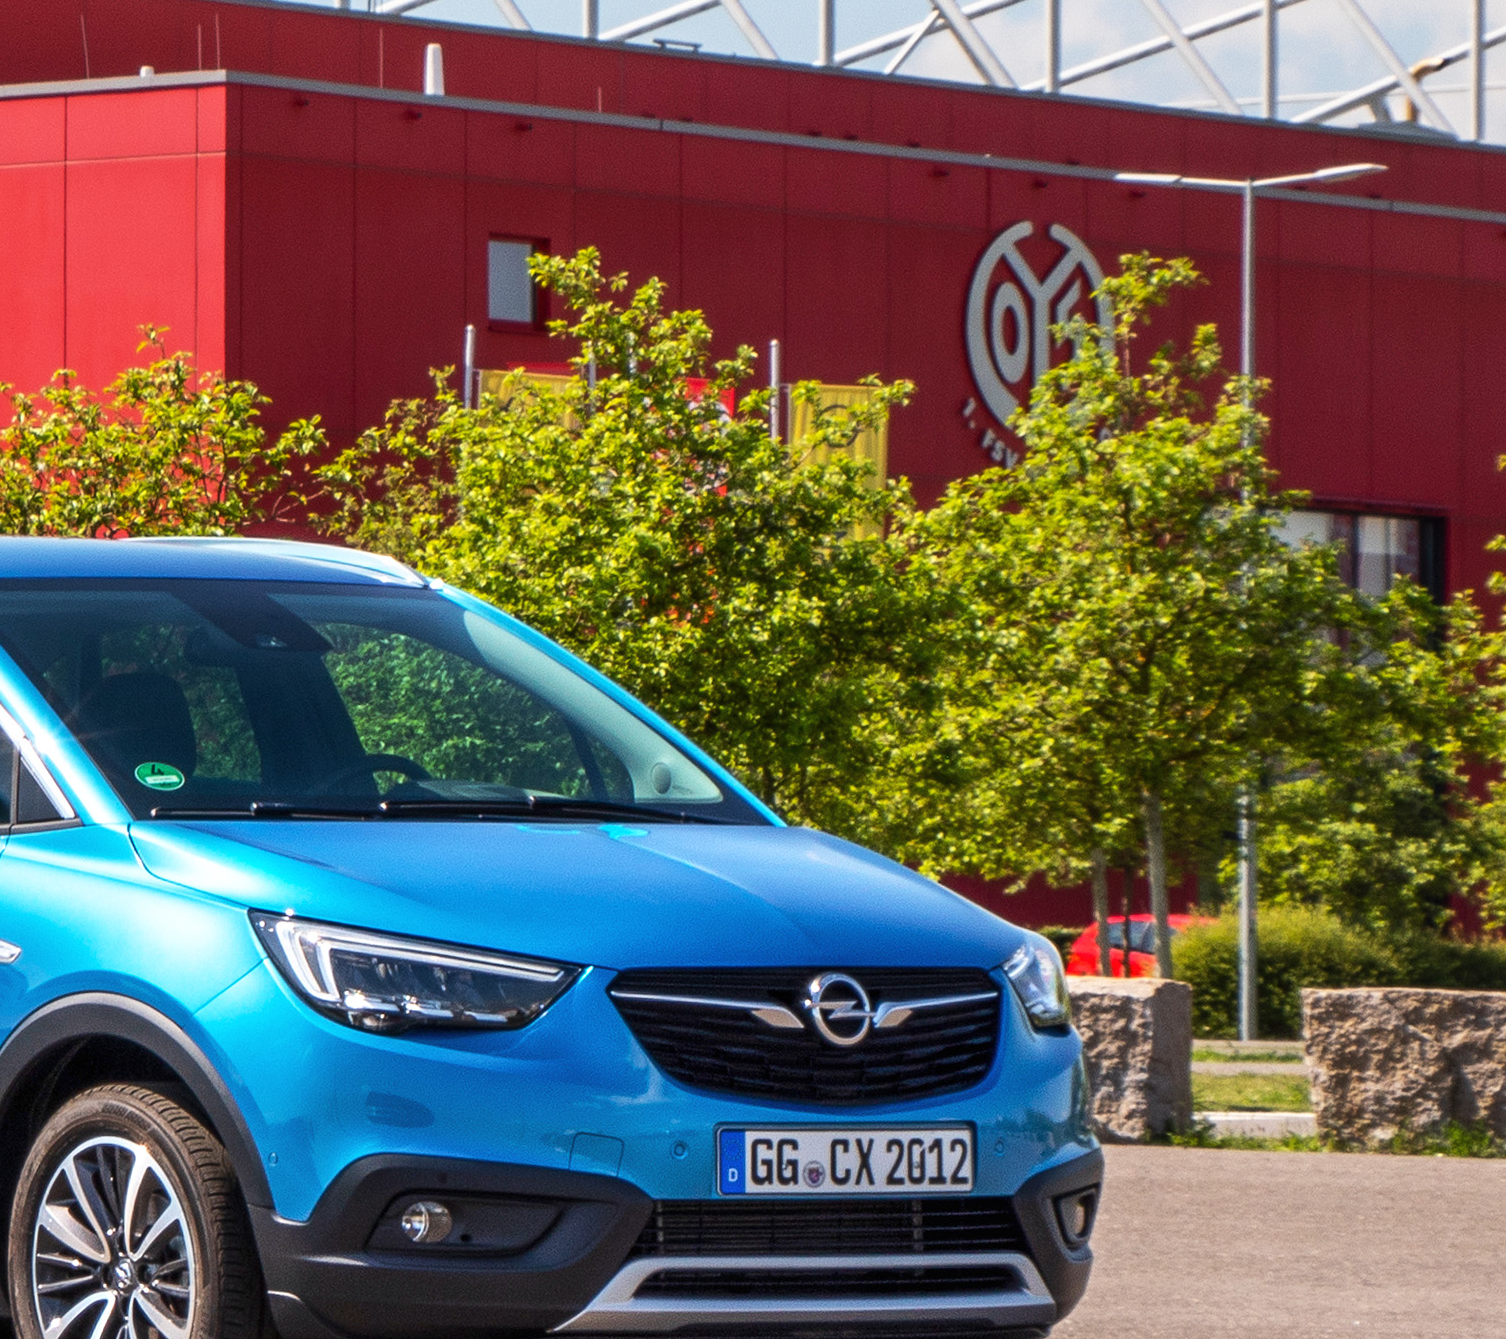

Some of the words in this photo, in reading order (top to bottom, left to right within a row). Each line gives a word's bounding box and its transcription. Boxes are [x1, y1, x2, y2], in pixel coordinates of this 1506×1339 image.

[728, 1167, 738, 1181] D
[750, 1138, 799, 1186] GG
[830, 1138, 875, 1186] CX
[886, 1138, 969, 1186] 2012
